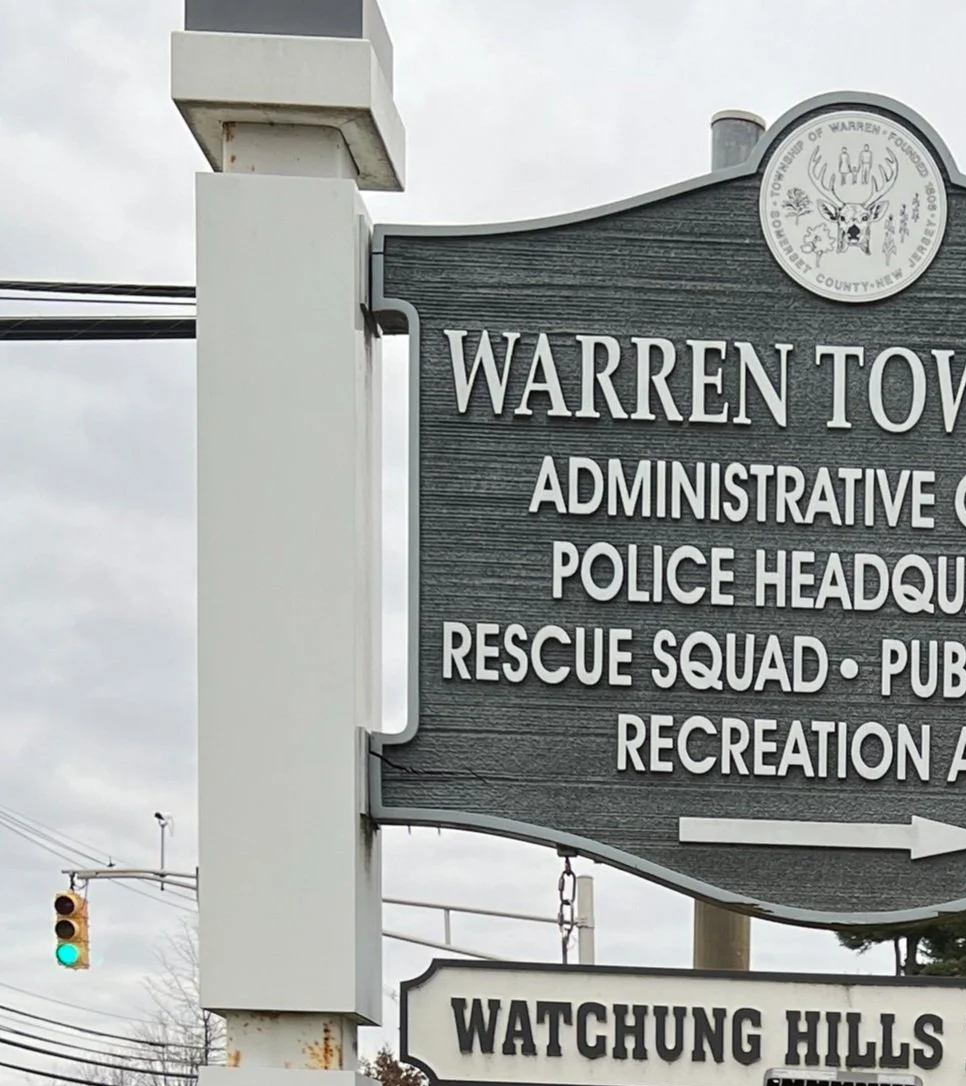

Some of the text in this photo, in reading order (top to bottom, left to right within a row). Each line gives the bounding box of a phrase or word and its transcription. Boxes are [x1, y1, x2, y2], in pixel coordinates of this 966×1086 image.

[770, 121, 881, 197] TOWNSHIP OF WARREN
[887, 131, 930, 179] FOUNDED
[769, 211, 871, 292] SOMERSET COUNTY
[875, 219, 938, 290] NEW JERSEY
[443, 329, 794, 427] WARREN
[528, 455, 936, 529] ADMINISTRATIVE
[552, 540, 735, 607] POLICE
[443, 621, 633, 687] RESCUE
[651, 629, 829, 695] SQUAD
[617, 713, 931, 782] RECREATION
[450, 997, 762, 1067] WATCHUNG
[784, 1010, 944, 1071] HILLS
